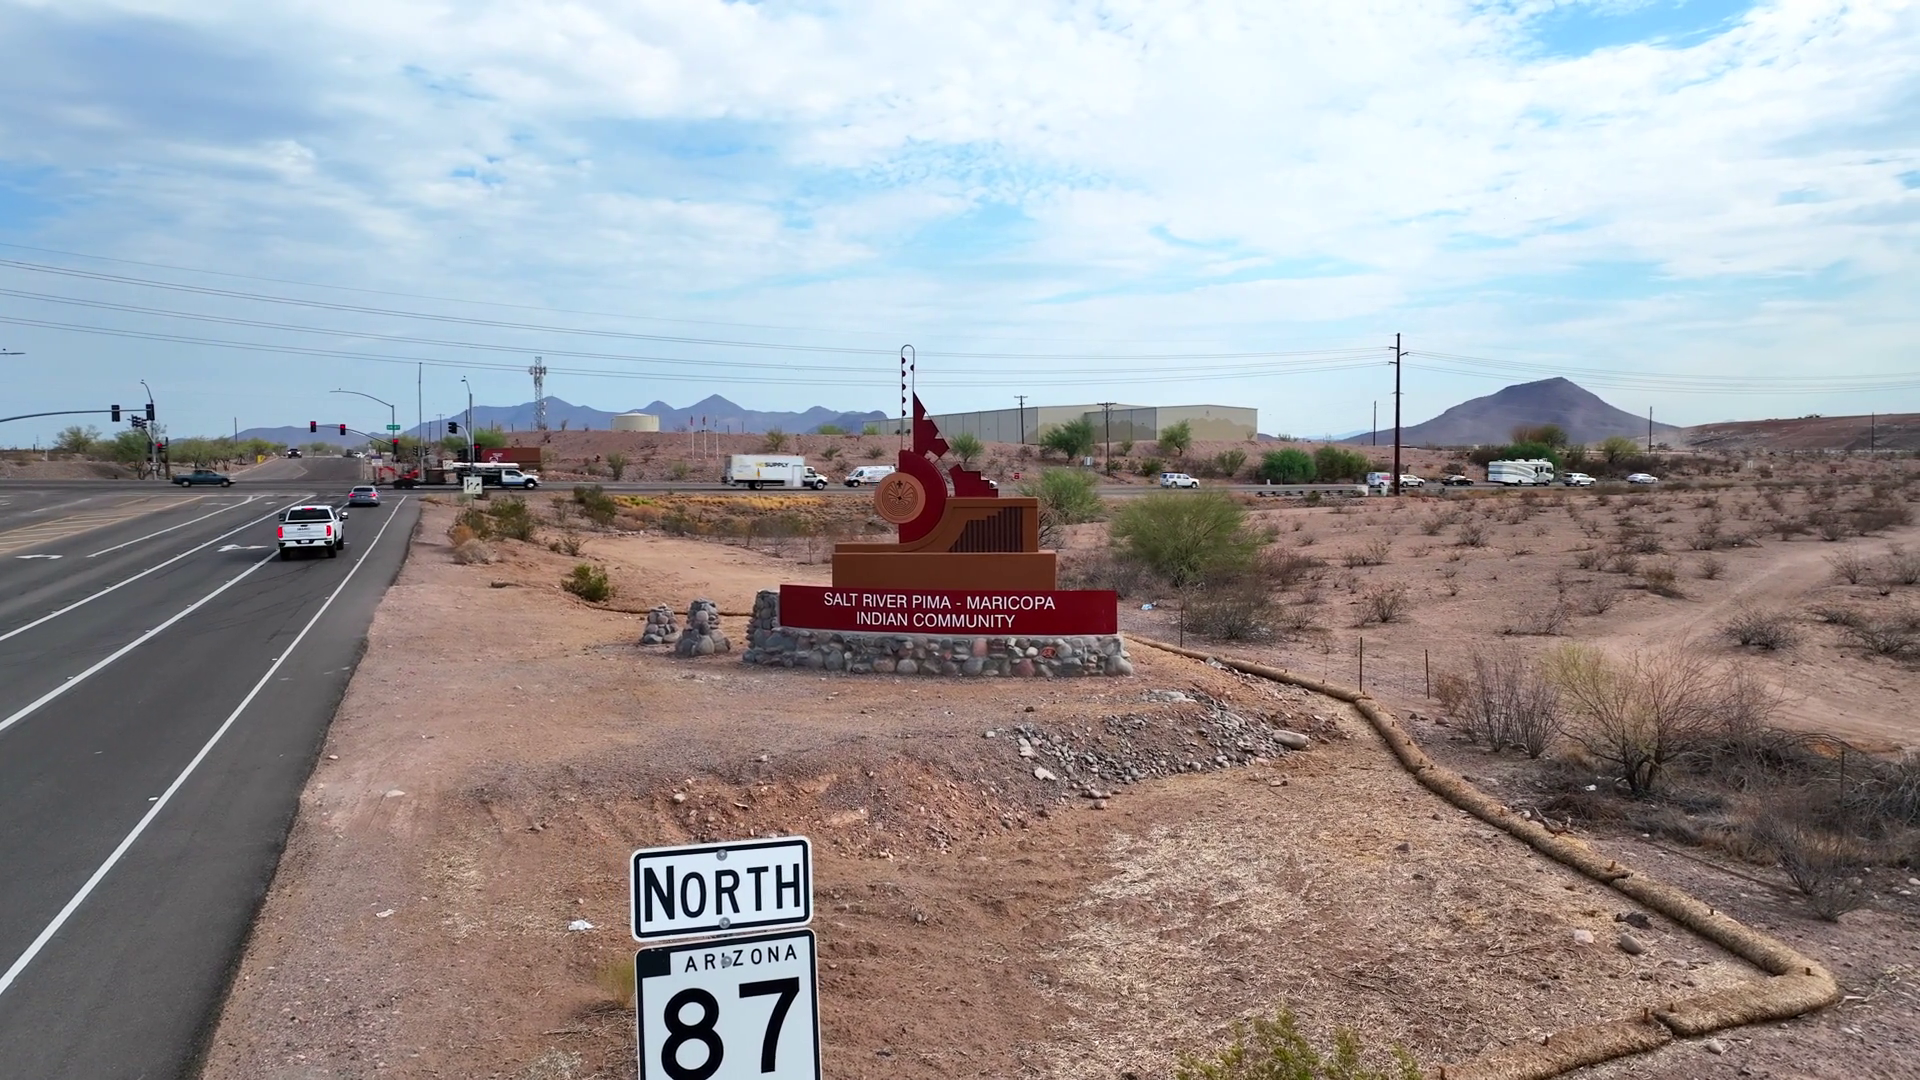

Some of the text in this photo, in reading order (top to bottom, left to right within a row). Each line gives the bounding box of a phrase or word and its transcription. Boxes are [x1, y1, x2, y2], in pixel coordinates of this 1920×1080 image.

[823, 592, 859, 607] SALT
[862, 593, 907, 609] RIVER
[912, 594, 952, 609] PIMA
[966, 595, 1056, 610] MARICOPA
[856, 611, 1016, 628] INDIAN COMMUNITY
[643, 863, 801, 922] NORTH
[661, 976, 800, 1080] 87
